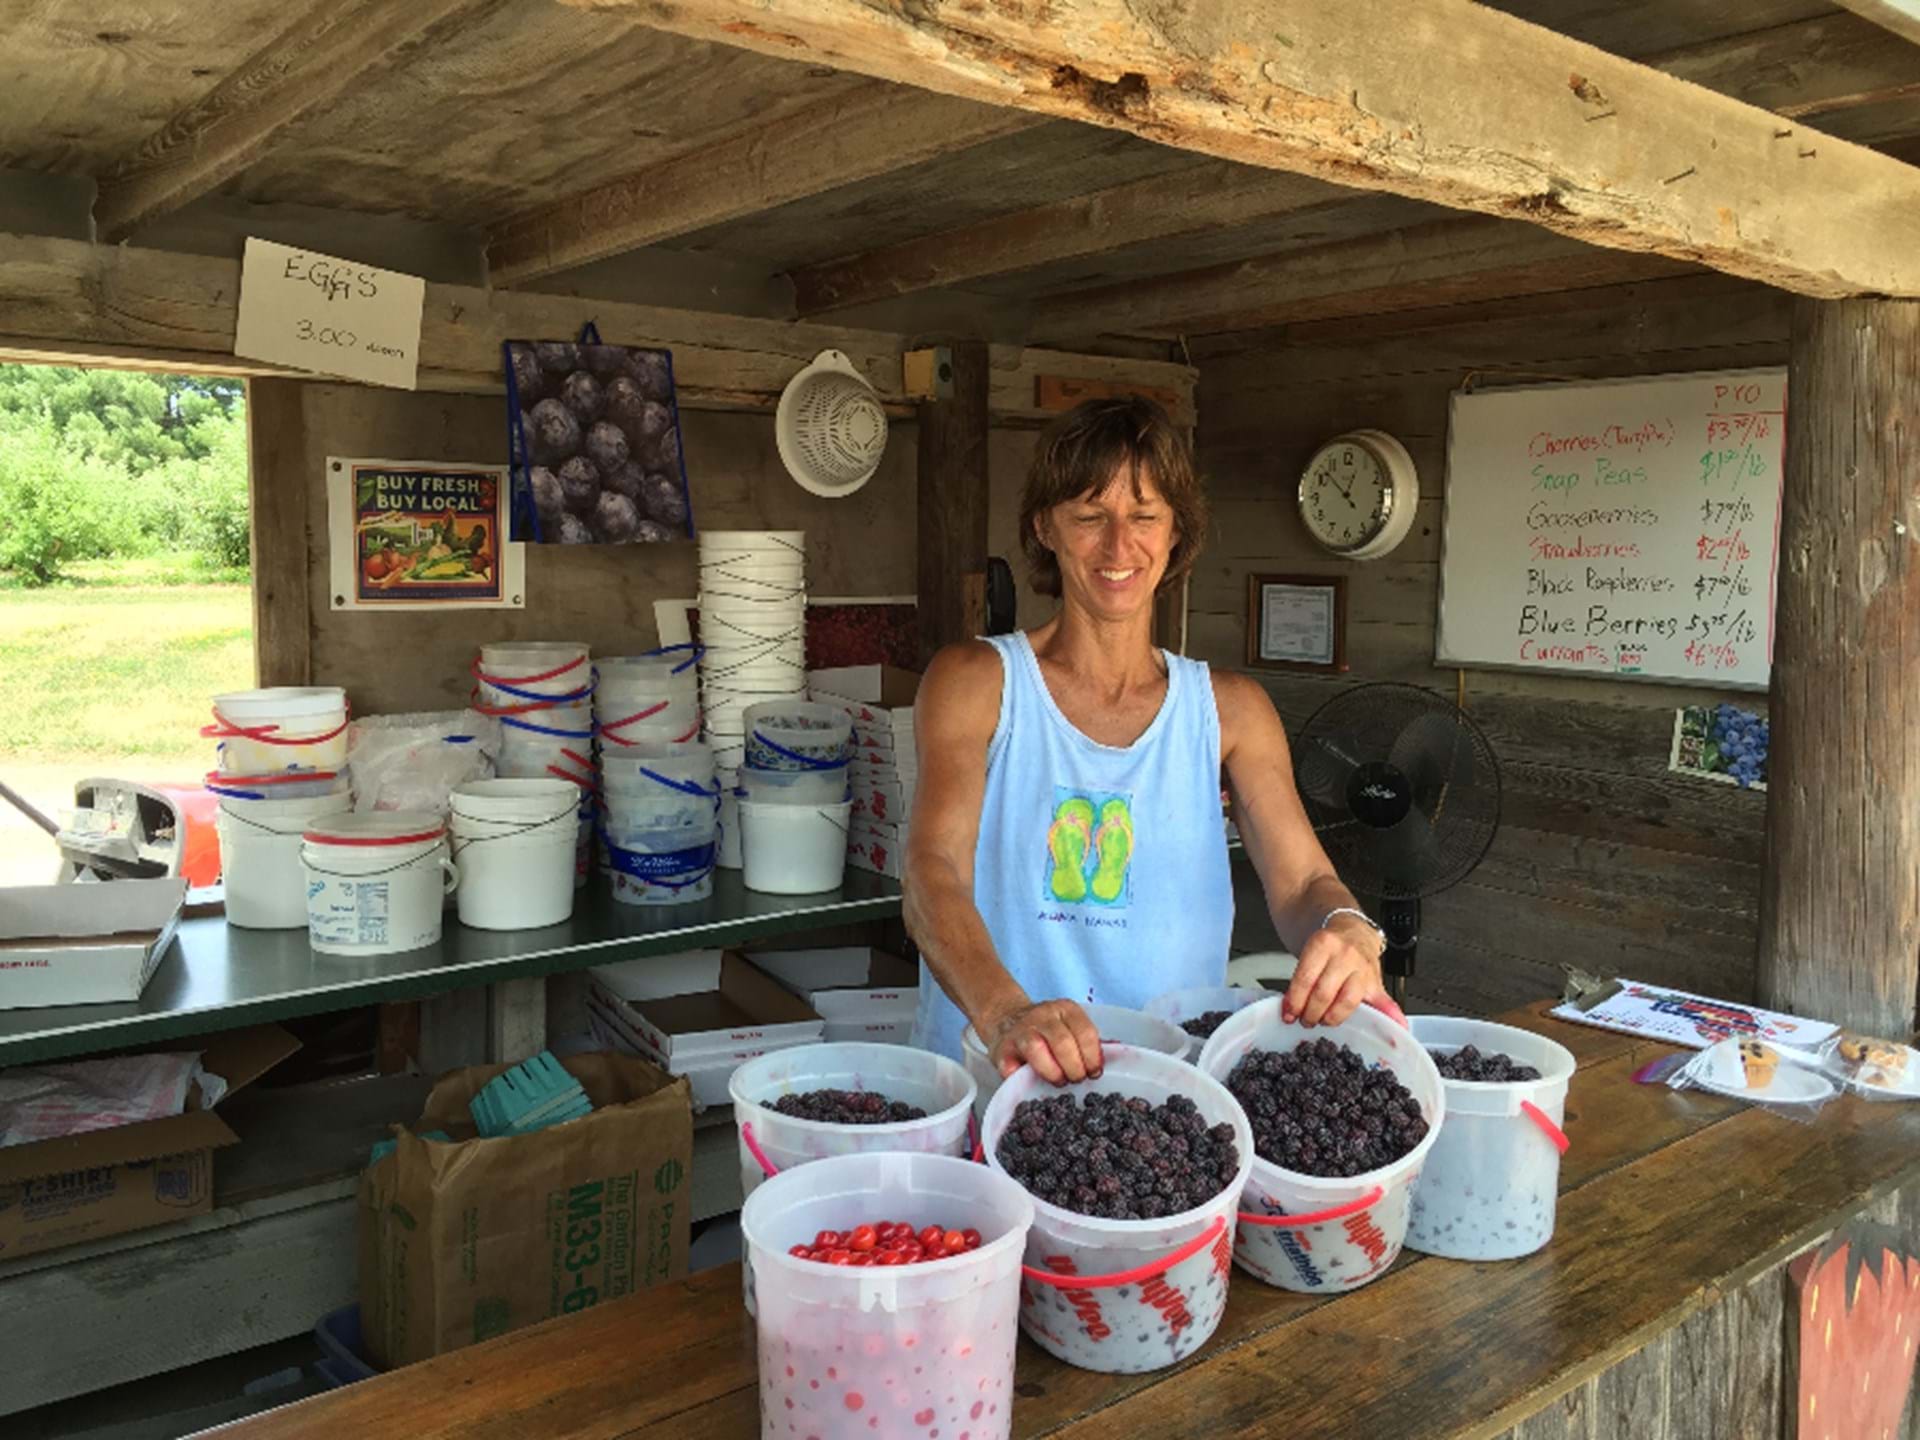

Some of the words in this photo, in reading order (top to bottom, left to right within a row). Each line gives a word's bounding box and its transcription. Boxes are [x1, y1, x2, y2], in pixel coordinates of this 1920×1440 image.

[283, 254, 378, 301] EGGS
[377, 475, 416, 490] BUY
[421, 477, 479, 493] FRESH
[1595, 457, 1648, 487] Peas
[377, 494, 416, 509] BUY
[421, 496, 480, 511] LOCAL
[1518, 604, 1576, 636] Blue
[1584, 604, 1678, 640] Berries
[1519, 639, 1609, 665] Currants
[615, 1175, 632, 1204] The
[613, 1208, 632, 1270] Garden
